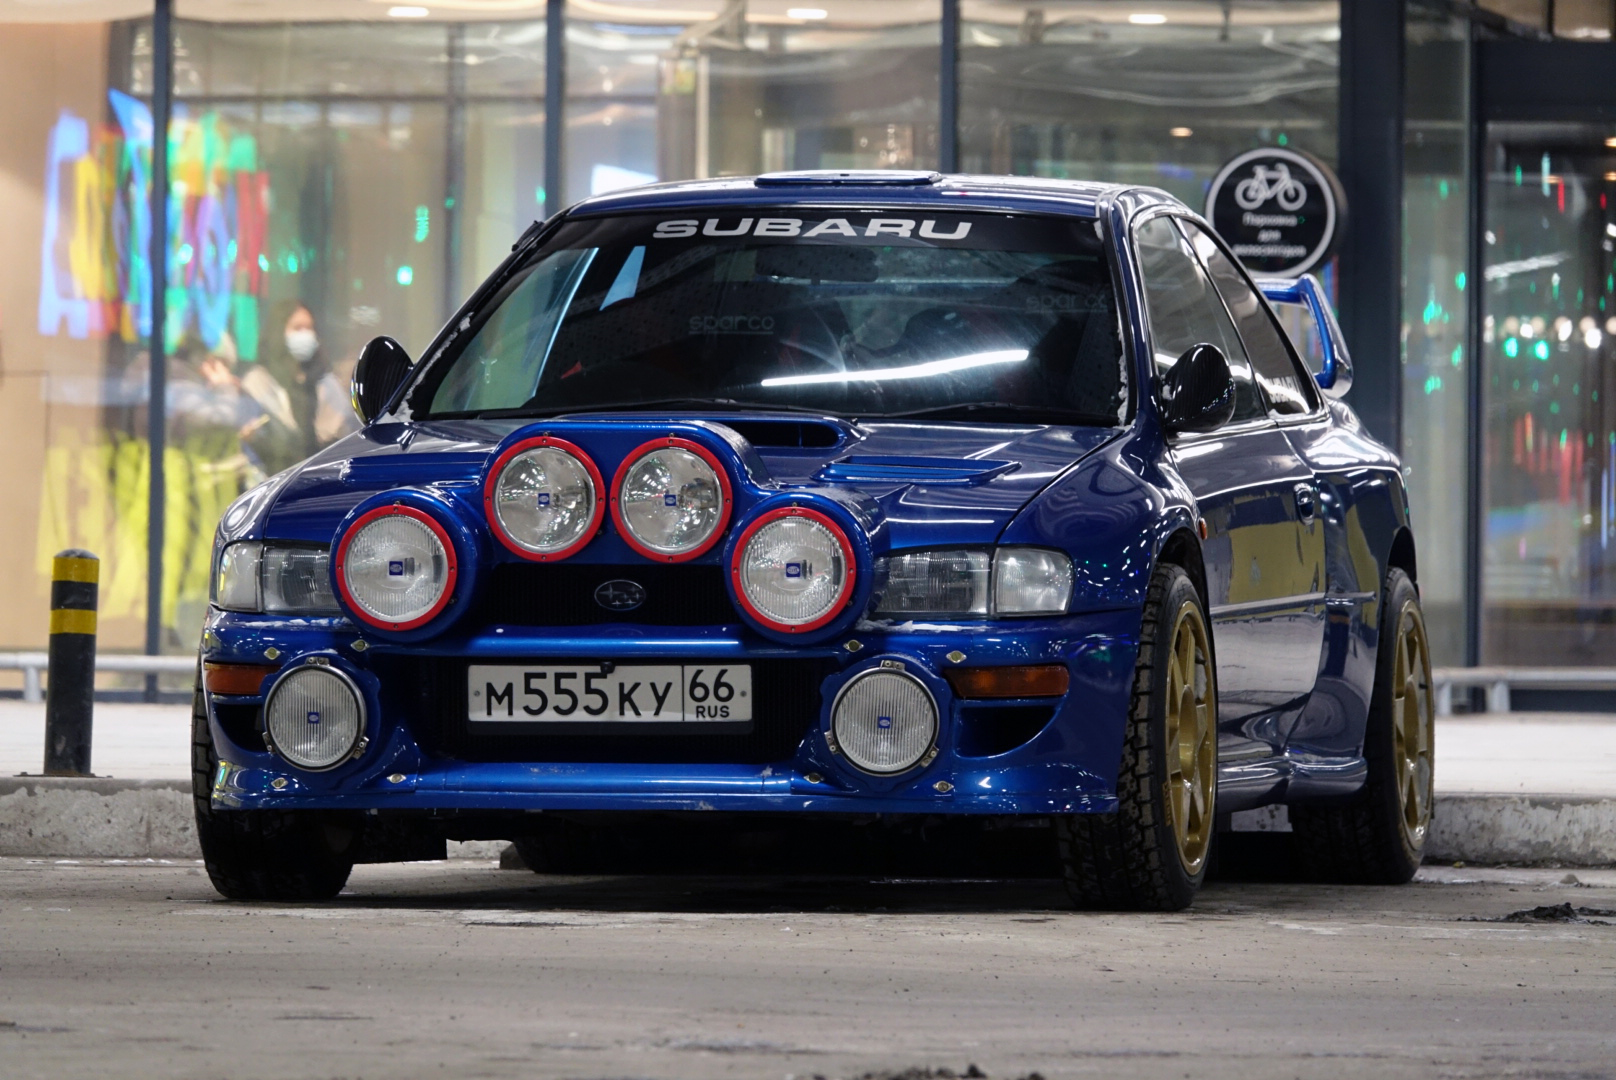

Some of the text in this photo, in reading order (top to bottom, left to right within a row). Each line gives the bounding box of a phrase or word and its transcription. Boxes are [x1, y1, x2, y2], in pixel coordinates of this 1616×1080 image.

[653, 218, 973, 240] SUBARU
[689, 315, 775, 334] sparco
[689, 669, 735, 703] 66
[695, 705, 730, 718] RUS
